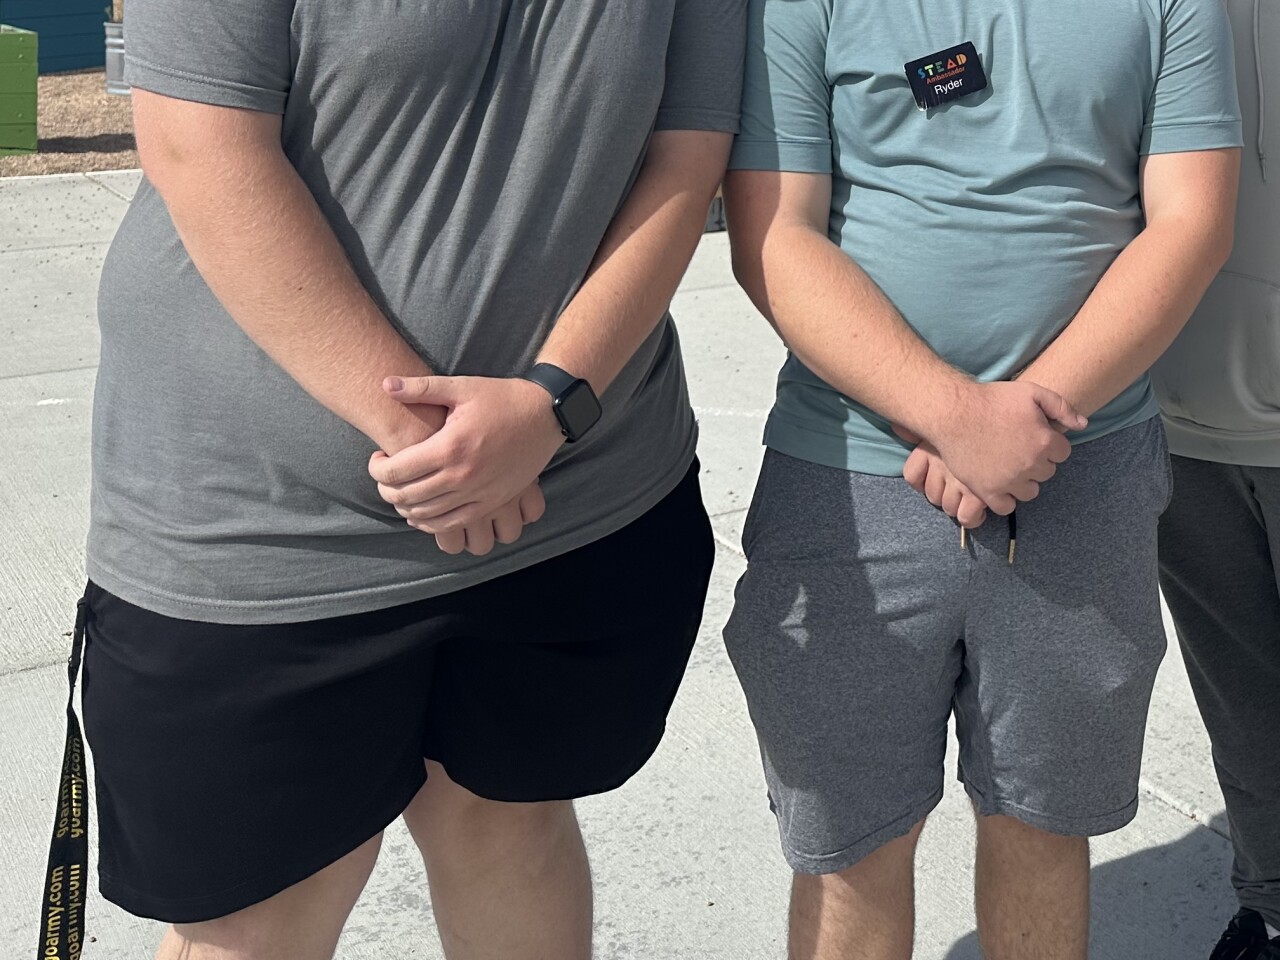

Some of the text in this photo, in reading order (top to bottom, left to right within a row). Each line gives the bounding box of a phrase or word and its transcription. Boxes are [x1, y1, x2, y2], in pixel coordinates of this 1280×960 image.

[917, 53, 967, 79] STEAD
[926, 66, 966, 85] Ambassador
[934, 78, 963, 95] Ryder
